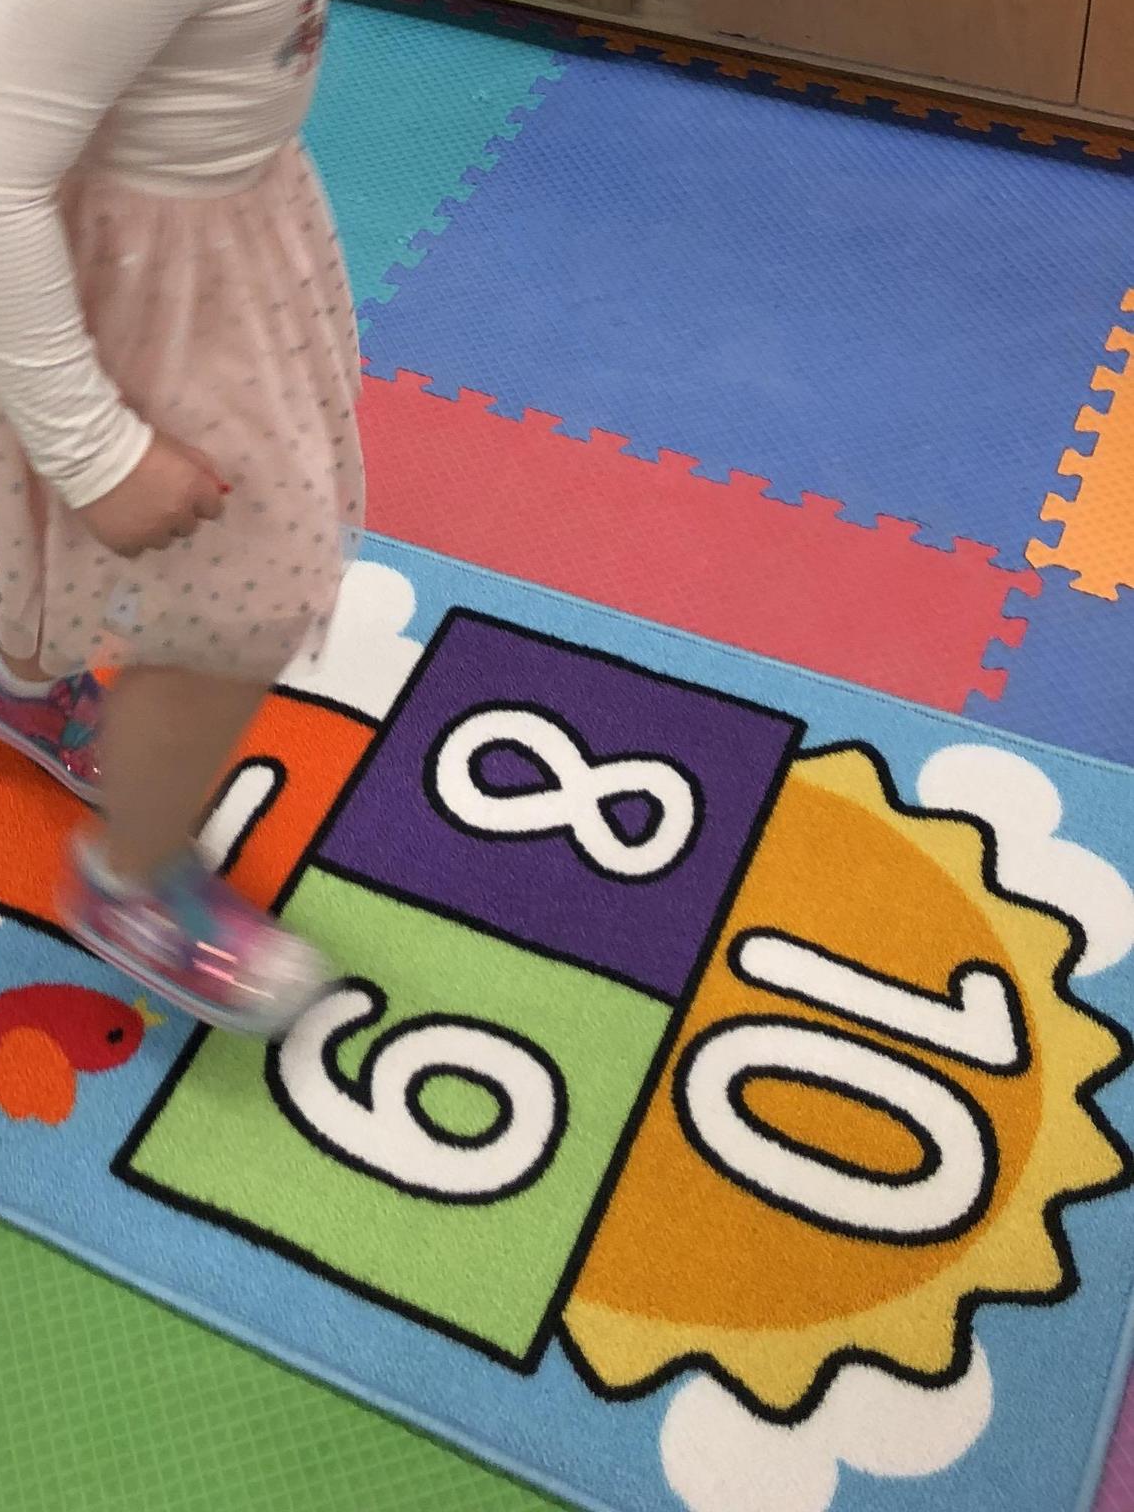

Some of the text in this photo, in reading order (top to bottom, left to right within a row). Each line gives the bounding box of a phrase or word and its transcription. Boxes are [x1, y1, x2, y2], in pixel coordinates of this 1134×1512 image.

[423, 699, 705, 884] 8
[266, 976, 569, 1206] 9
[672, 926, 1032, 1245] 10
